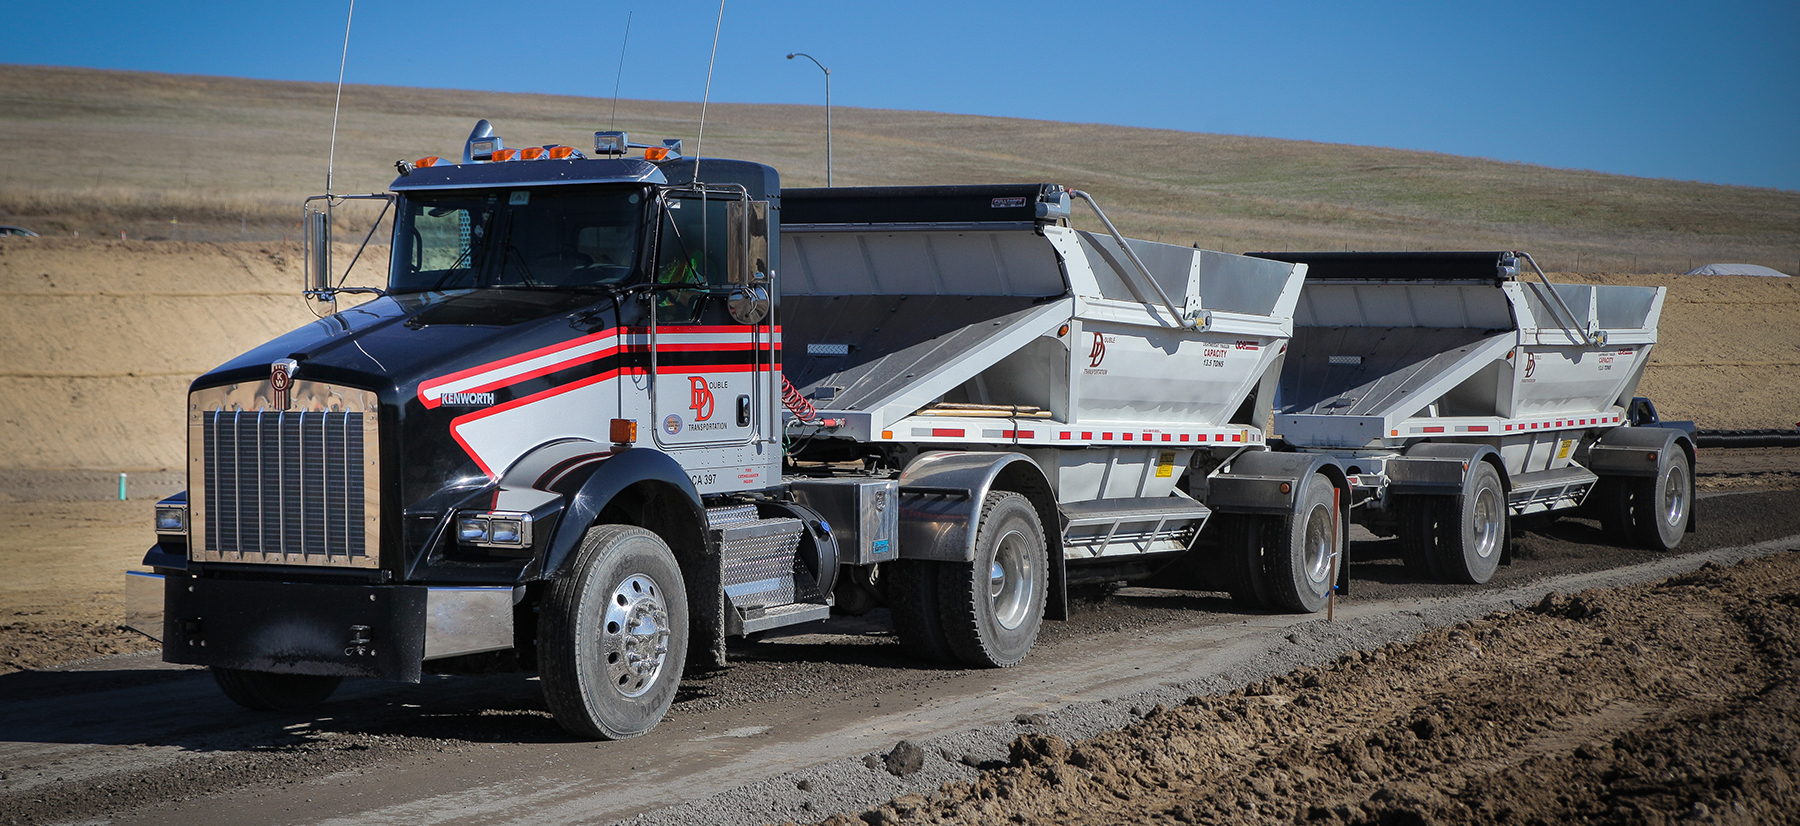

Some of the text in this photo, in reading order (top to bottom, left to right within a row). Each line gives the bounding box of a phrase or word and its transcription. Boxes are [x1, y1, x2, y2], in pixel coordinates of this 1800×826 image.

[1203, 349, 1227, 358] CAPACITY
[1213, 360, 1224, 368] TONS
[441, 393, 495, 405] KENWORTH
[688, 422, 728, 432] TRANSPORTATION
[691, 474, 717, 486] CA 397
